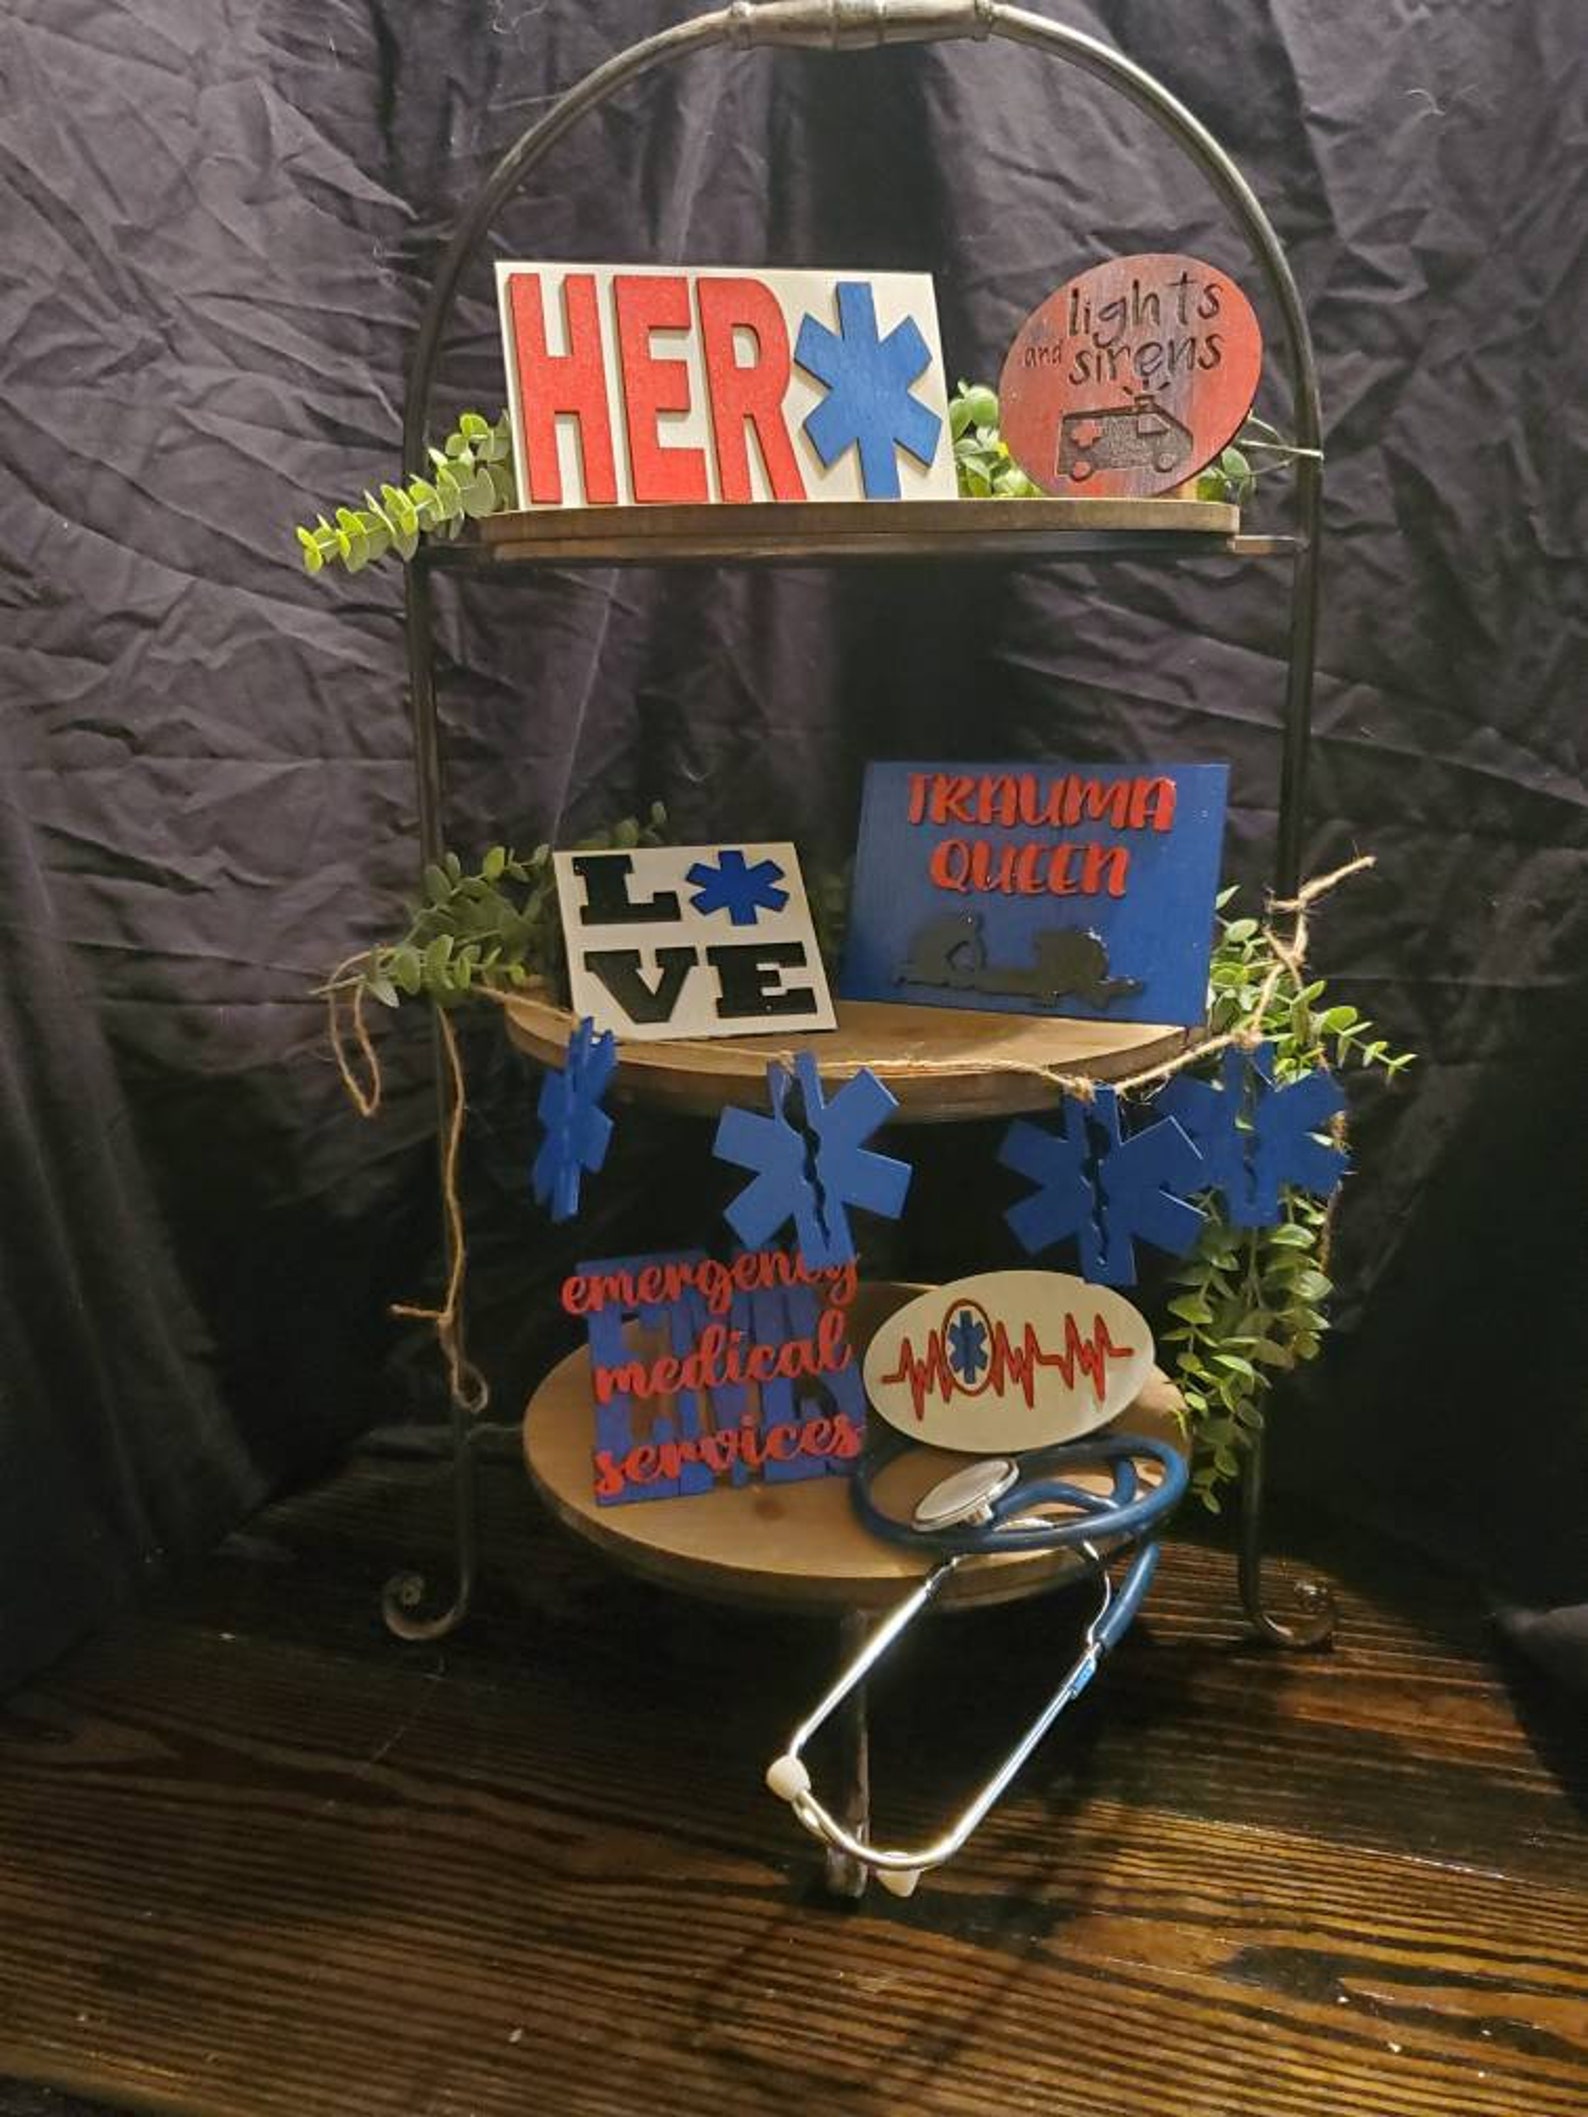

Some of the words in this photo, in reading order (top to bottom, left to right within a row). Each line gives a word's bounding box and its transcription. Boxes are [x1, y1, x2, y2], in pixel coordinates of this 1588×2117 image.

[1068, 271, 1223, 349] lights
[508, 273, 807, 504] HER
[1024, 339, 1063, 368] and
[1068, 333, 1224, 386] sirens
[907, 772, 1177, 833] TRAUMA
[928, 838, 1130, 898] QUEEN
[593, 1308, 852, 1405] medical
[594, 1413, 862, 1497] services
